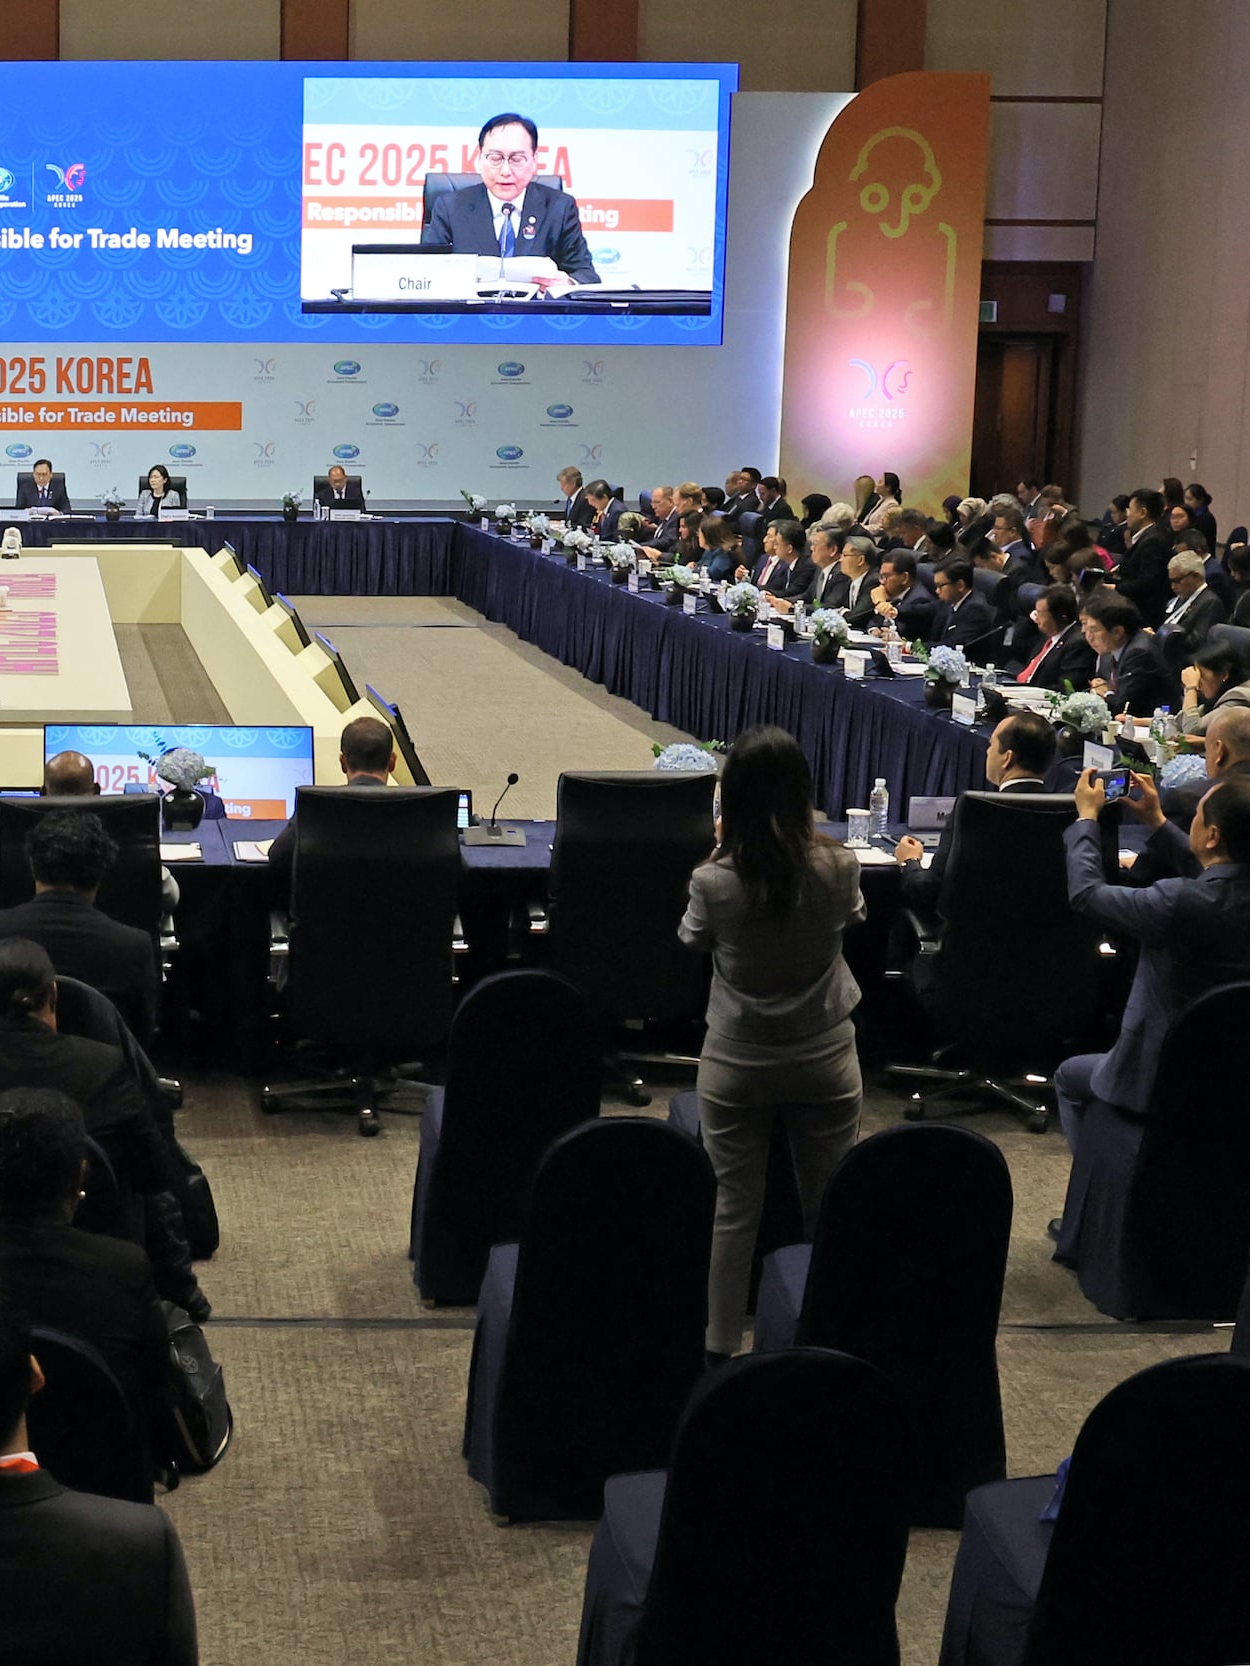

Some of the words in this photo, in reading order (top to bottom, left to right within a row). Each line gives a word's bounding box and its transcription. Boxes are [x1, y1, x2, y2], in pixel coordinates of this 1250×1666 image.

[359, 143, 449, 187] 2025
[461, 144, 572, 188] KEA
[47, 194, 64, 202] APEC
[307, 201, 423, 226] Responsibl
[49, 228, 84, 250] for
[87, 228, 152, 250] Trade
[156, 228, 253, 255] Meeting
[398, 276, 432, 291] Chair
[57, 357, 153, 394] KOREA
[37, 406, 65, 423] for
[67, 407, 117, 423] Trade
[120, 407, 194, 427] Meeting
[848, 408, 875, 419] APEC
[96, 764, 139, 791] 025
